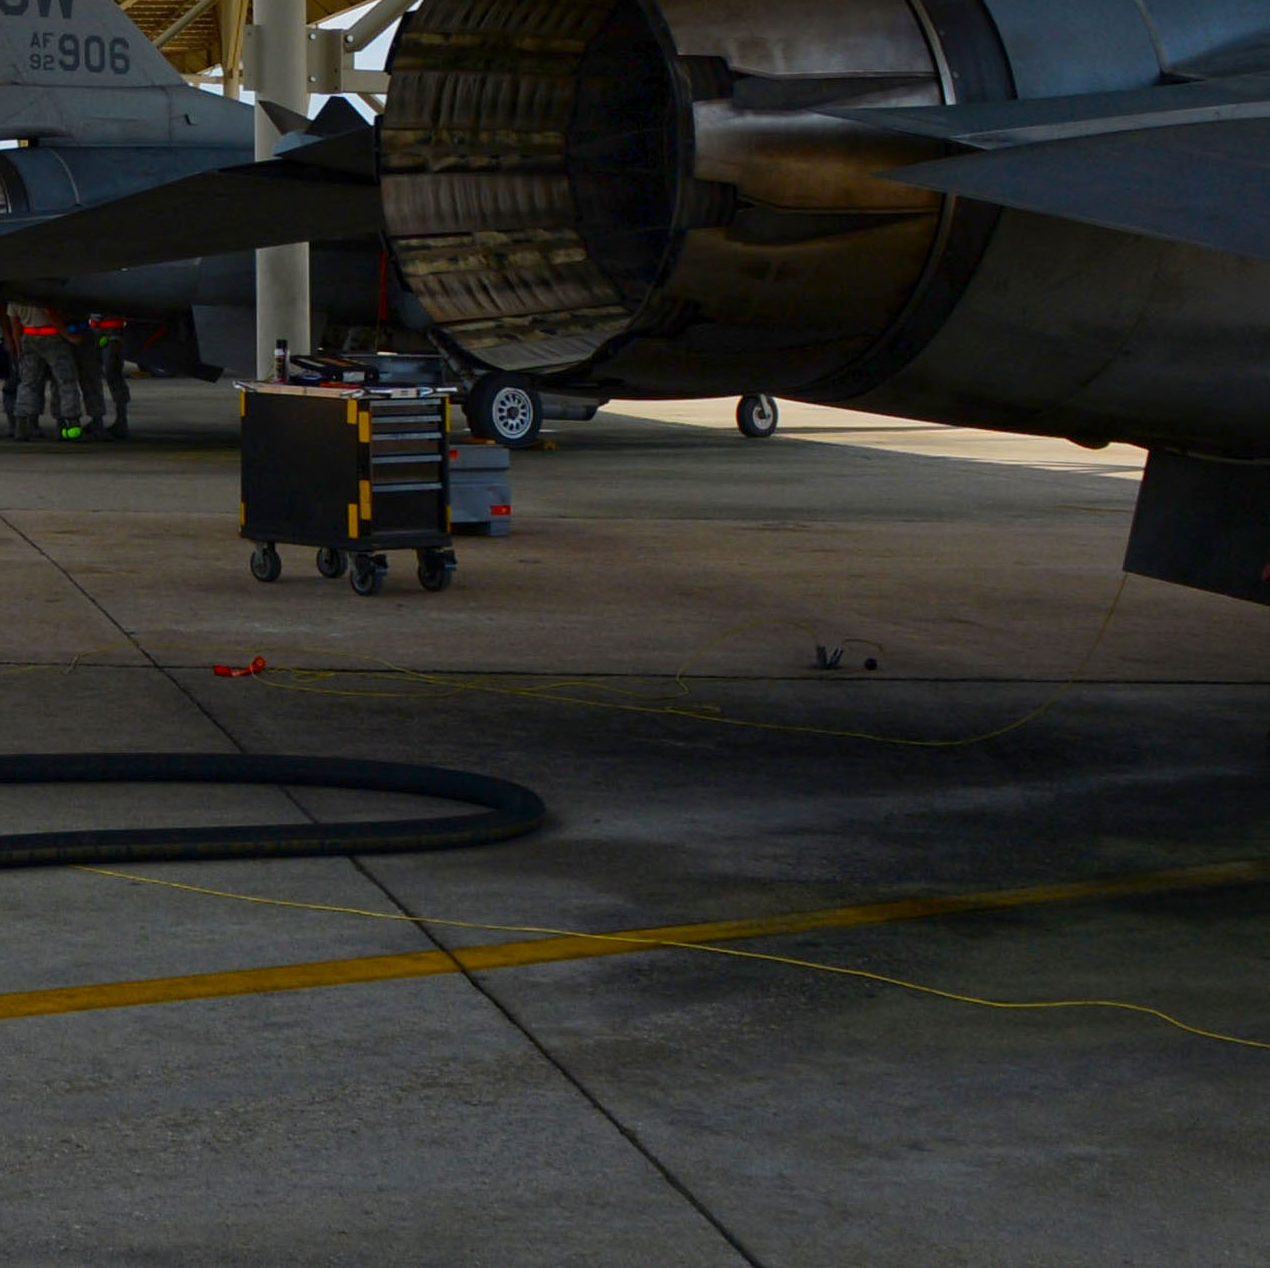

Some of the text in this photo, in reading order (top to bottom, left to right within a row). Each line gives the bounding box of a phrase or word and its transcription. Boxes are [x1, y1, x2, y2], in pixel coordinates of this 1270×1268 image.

[29, 54, 55, 71] 92
[30, 32, 130, 74] AF 906
